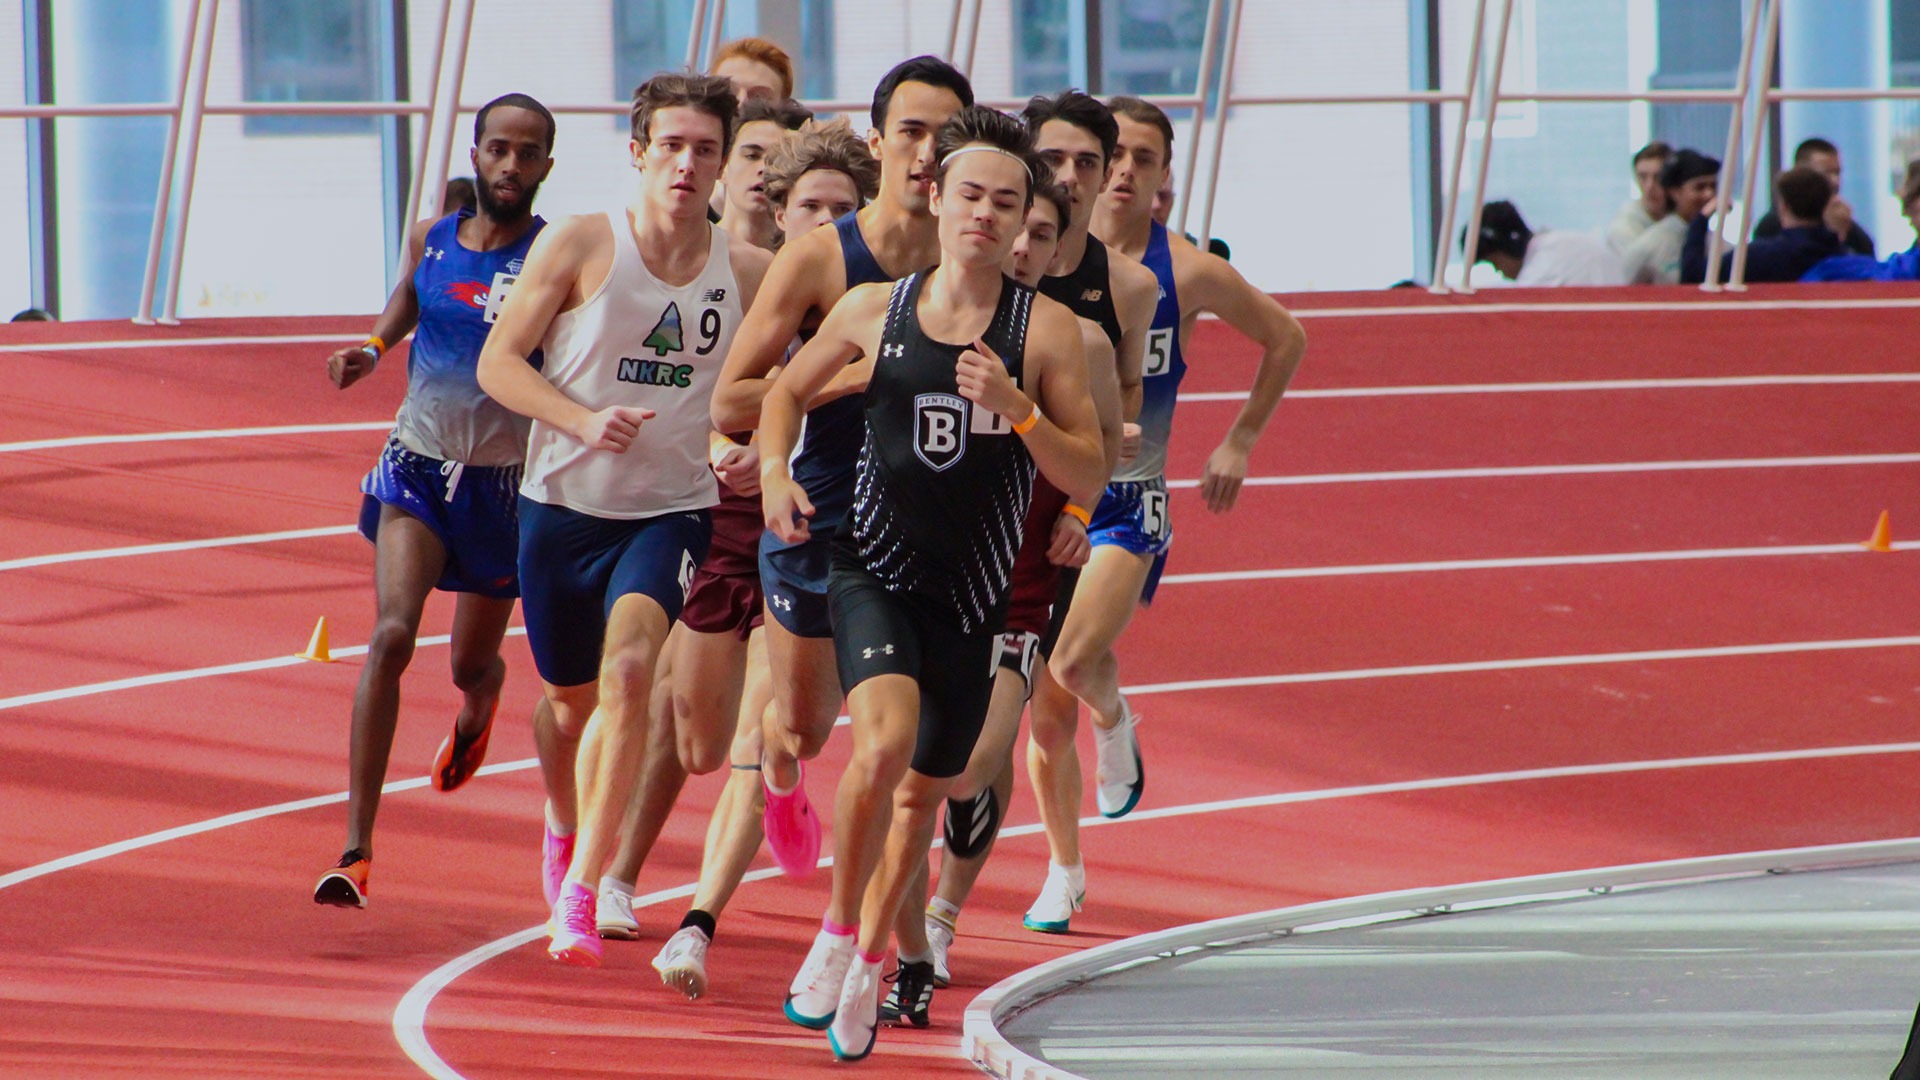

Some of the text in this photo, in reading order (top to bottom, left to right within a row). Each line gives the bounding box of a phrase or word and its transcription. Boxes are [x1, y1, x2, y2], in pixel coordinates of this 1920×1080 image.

[695, 308, 721, 355] 9
[617, 357, 694, 388] NKRC
[1147, 333, 1167, 374] 5
[918, 397, 964, 409] BENTLEY
[923, 410, 956, 453] B
[1151, 495, 1163, 537] 5
